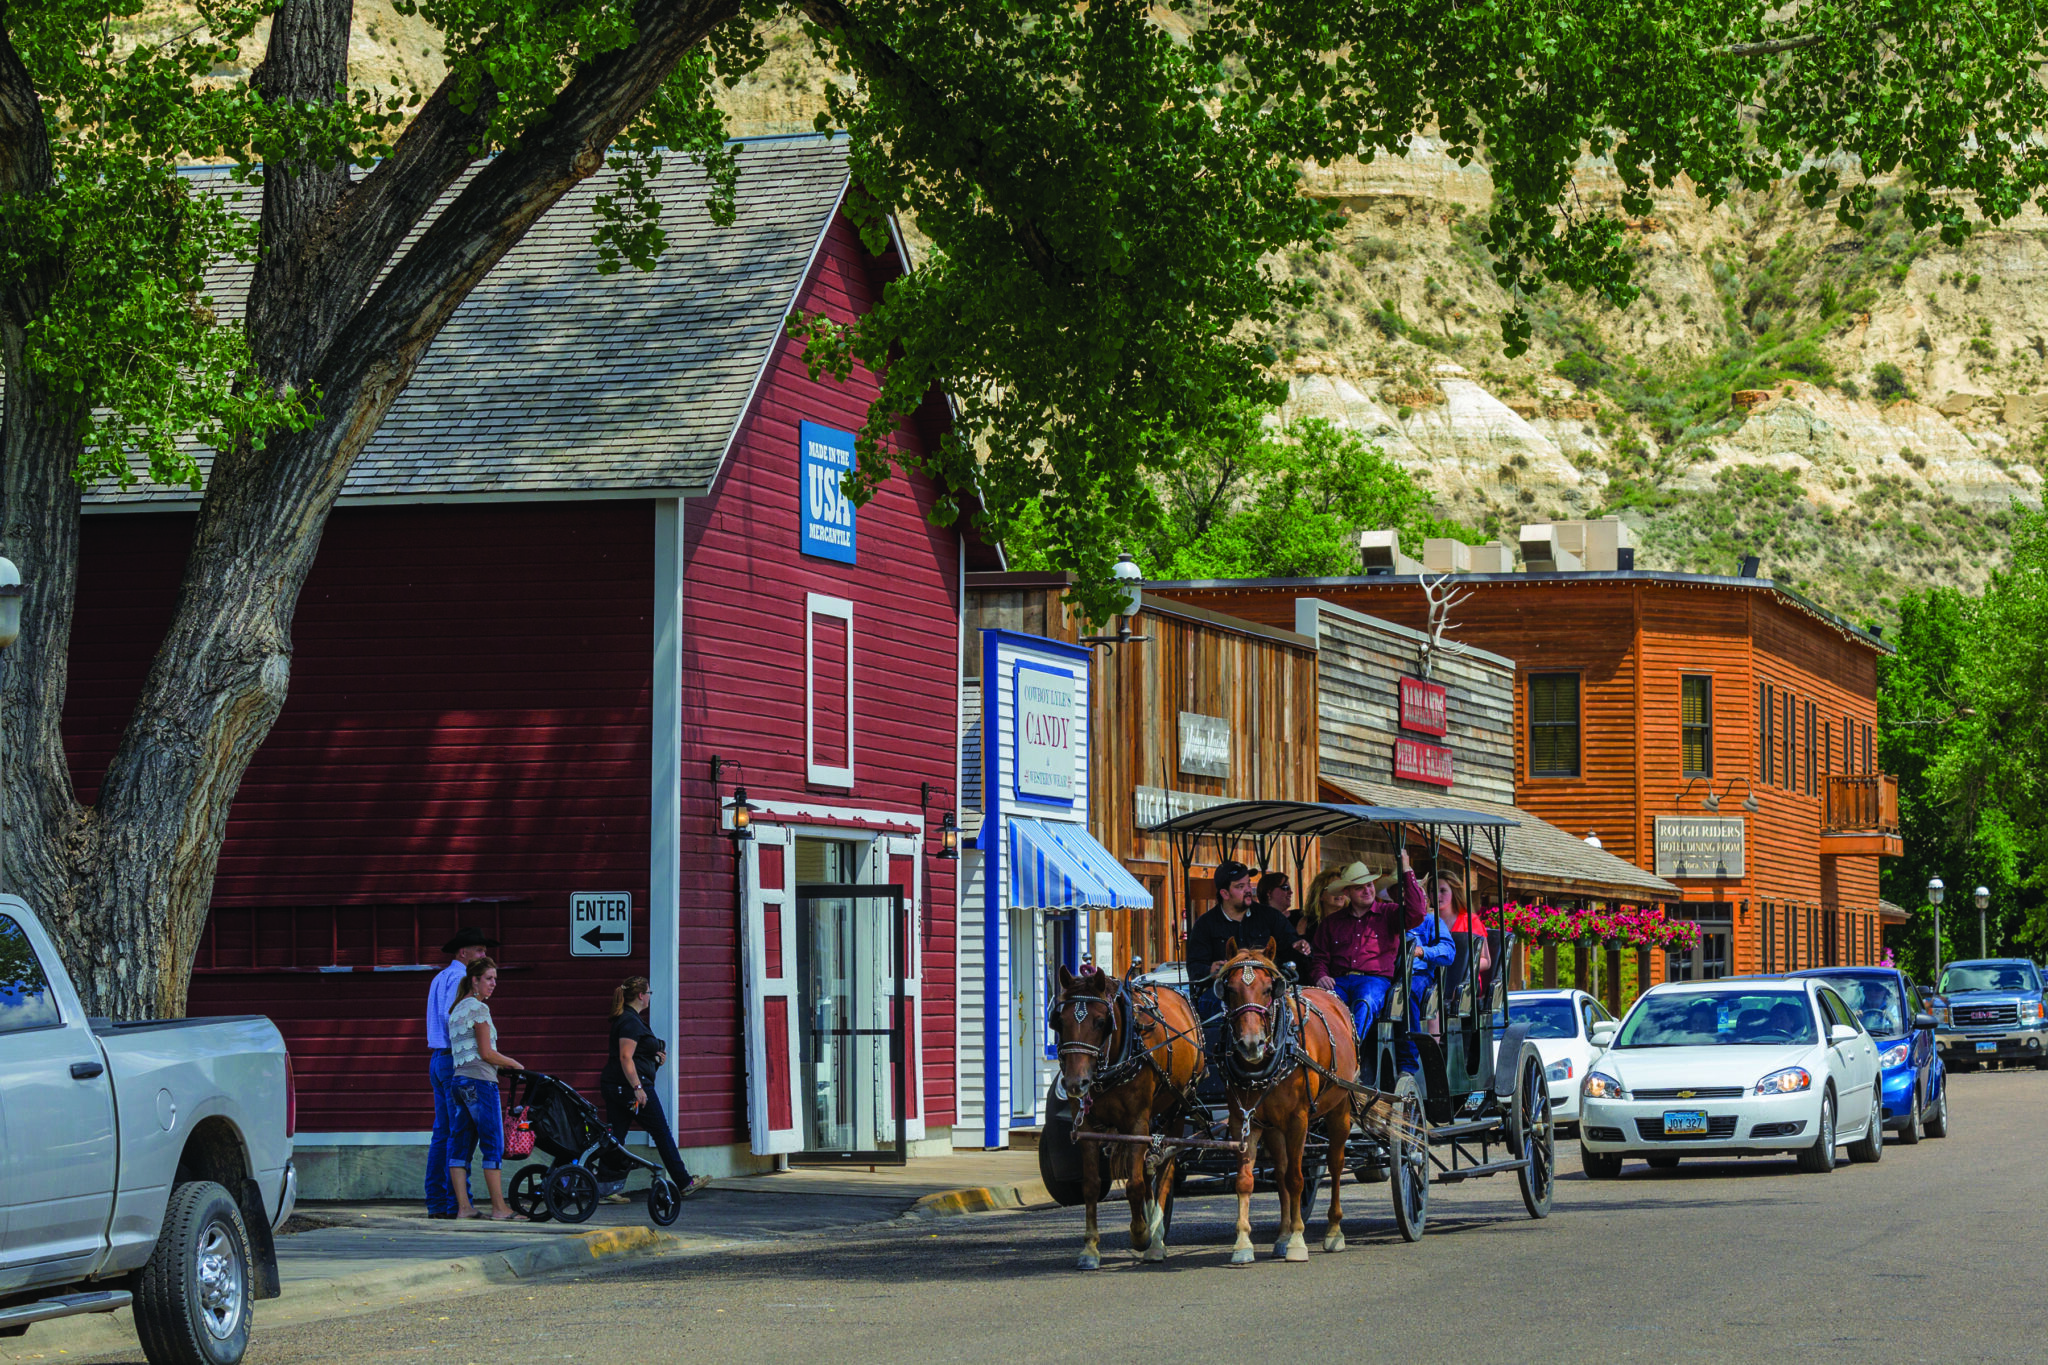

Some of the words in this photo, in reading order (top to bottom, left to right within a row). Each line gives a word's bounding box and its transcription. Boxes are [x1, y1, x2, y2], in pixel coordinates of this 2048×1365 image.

[808, 441, 828, 460] MADE
[829, 446, 836, 463] IN
[837, 449, 850, 467] THE
[808, 463, 851, 527] USA
[808, 523, 851, 547] MERCANTILE
[1024, 684, 1050, 704] COWBOY
[1026, 711, 1070, 749] CANDY
[1029, 770, 1052, 786] WESTERN
[1053, 773, 1067, 788] WEAR
[1137, 792, 1180, 825] TICKETS
[1660, 824, 1699, 837] ROUGH
[1702, 825, 1741, 838] RIDERS
[1660, 841, 1686, 852] HOTEL
[1687, 841, 1715, 852] DINING
[1717, 842, 1740, 852] ROOM
[576, 900, 626, 921] ENTER
[1667, 1118, 1683, 1129] JOY
[1686, 1117, 1702, 1128] 327
[231, 1209, 254, 1311] TRANSFORCE
